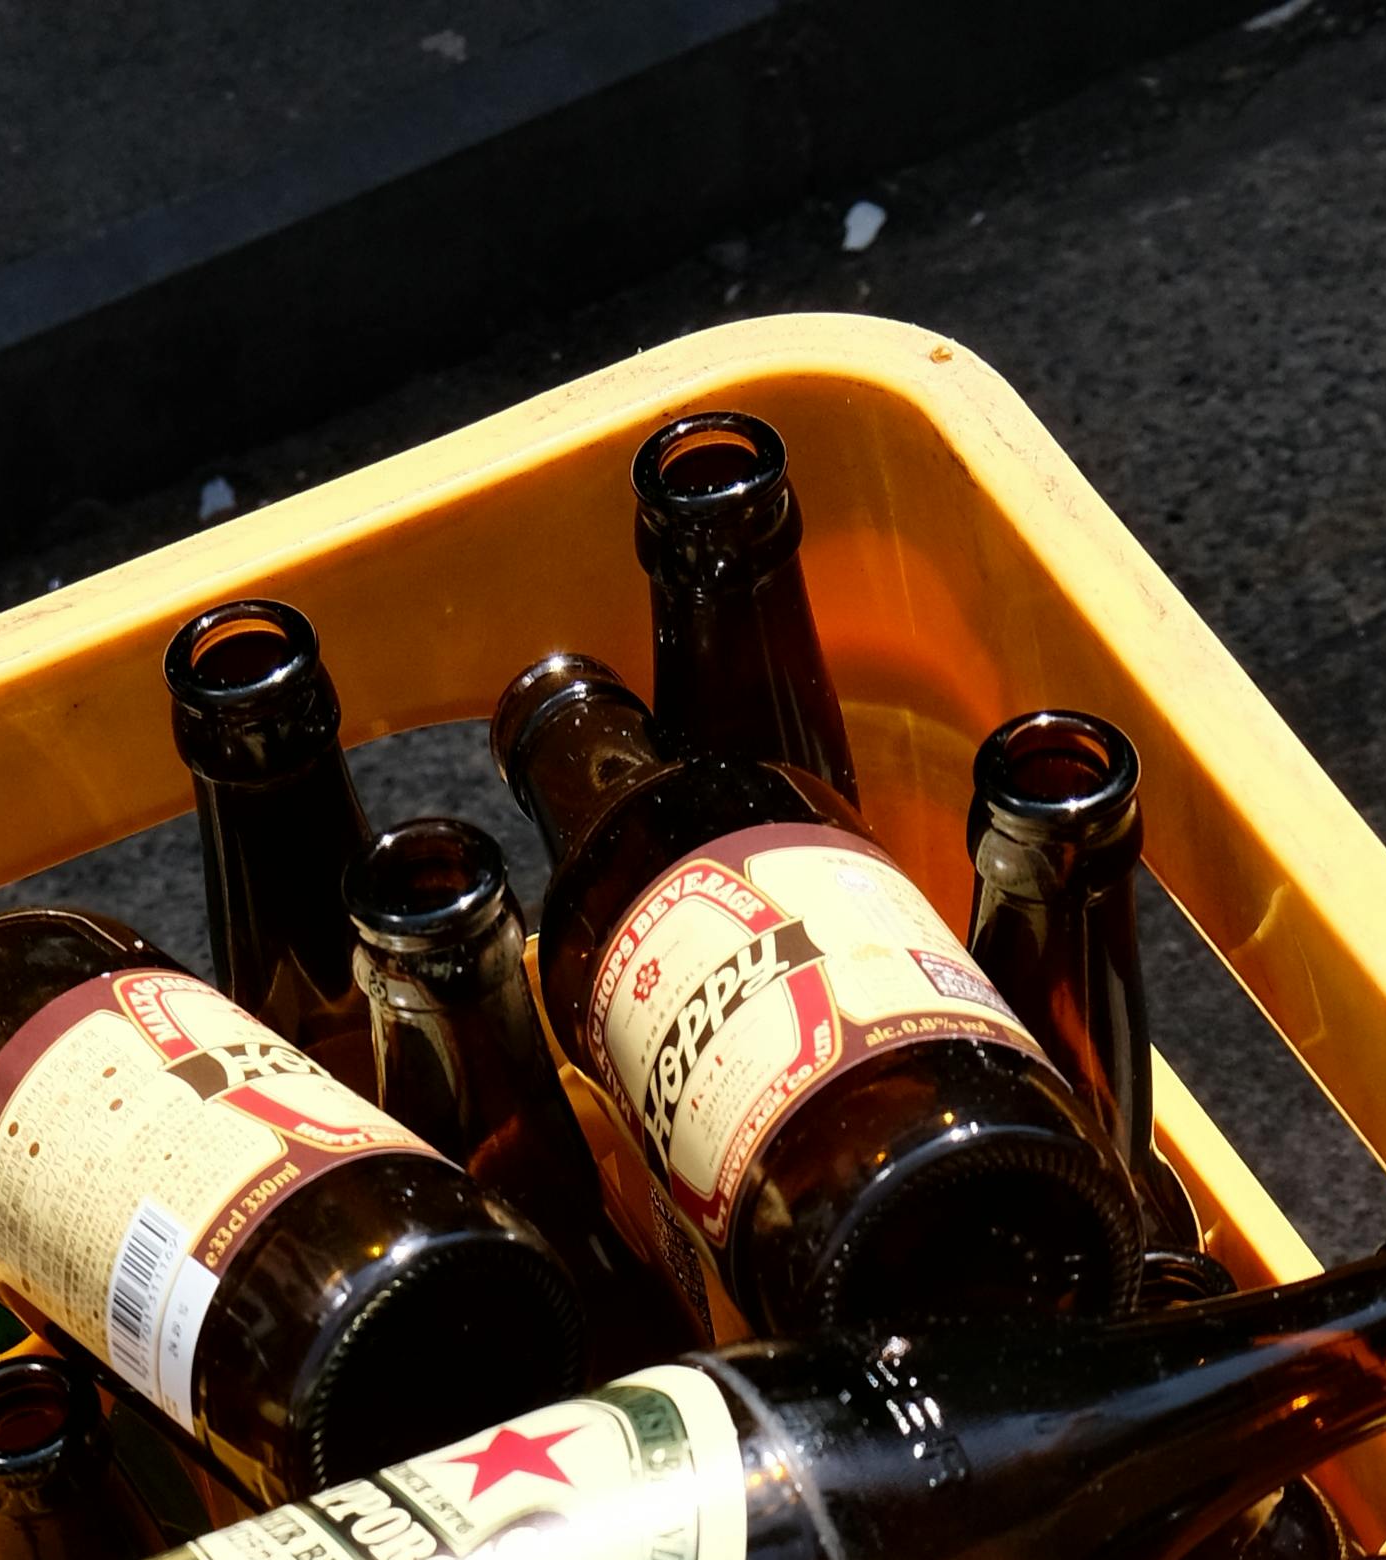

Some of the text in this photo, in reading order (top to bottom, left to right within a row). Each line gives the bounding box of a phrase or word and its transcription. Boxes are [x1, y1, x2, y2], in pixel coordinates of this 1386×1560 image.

[632, 870, 766, 940] BEVERAGE
[643, 931, 789, 1172] Hoppy
[240, 1159, 301, 1216] 330ml
